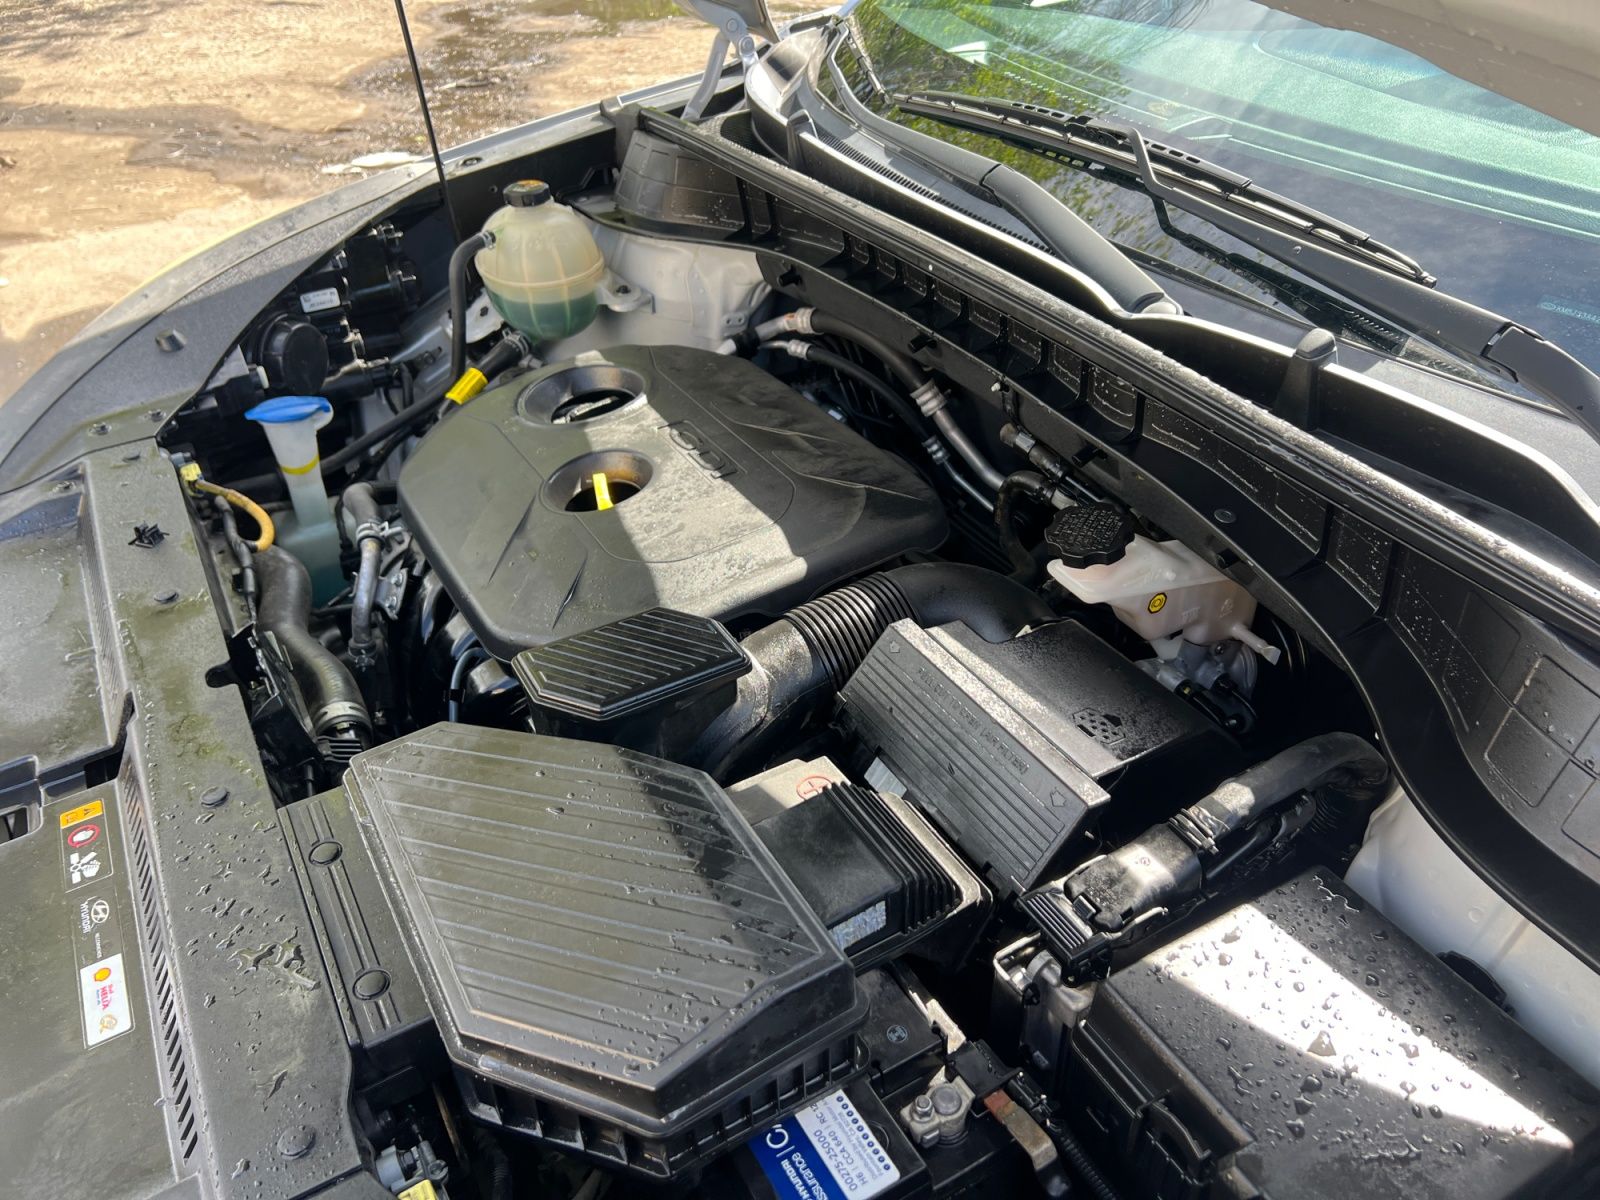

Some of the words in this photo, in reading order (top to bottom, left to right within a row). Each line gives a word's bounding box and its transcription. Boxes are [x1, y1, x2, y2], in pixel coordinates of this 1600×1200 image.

[669, 427, 739, 480] GDI
[80, 901, 91, 933] HYUNDAI
[815, 1111, 827, 1125] RC
[828, 1130, 842, 1147] 640
[813, 1128, 858, 1192] 00275-25000
[840, 1146, 855, 1165] CCA
[781, 1159, 810, 1199] HYUNDAI
[792, 1152, 829, 1200] ssurance
[856, 1171, 869, 1186] H6
